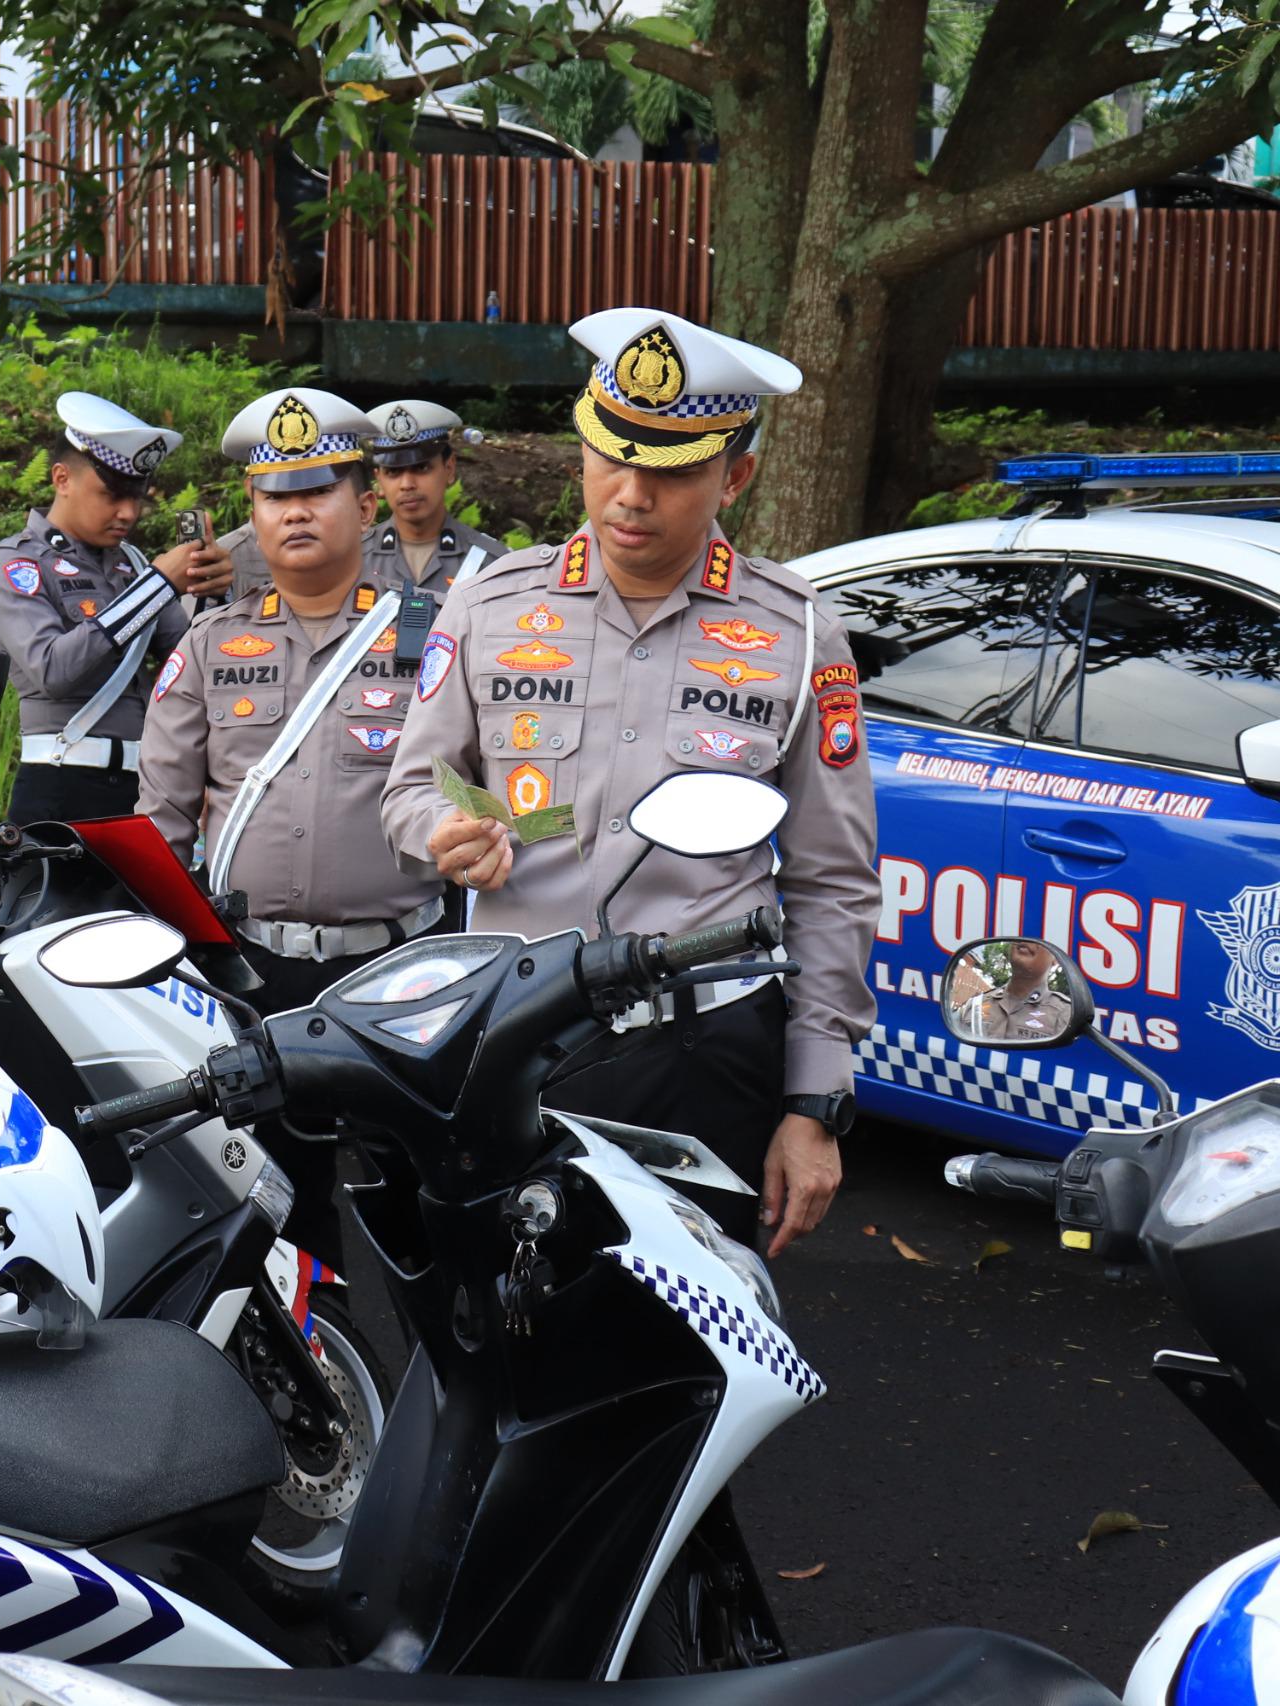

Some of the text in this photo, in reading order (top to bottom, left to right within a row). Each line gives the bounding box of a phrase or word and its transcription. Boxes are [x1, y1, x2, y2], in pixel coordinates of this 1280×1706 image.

[212, 664, 279, 686] FAUZI
[491, 676, 574, 703] DONI
[815, 667, 855, 689] POLDA
[680, 686, 774, 726] POLRI
[895, 751, 1212, 820] MELINDUNGI, MENGAYOMI DAN MELAYANI
[1093, 1006, 1181, 1052] TAS
